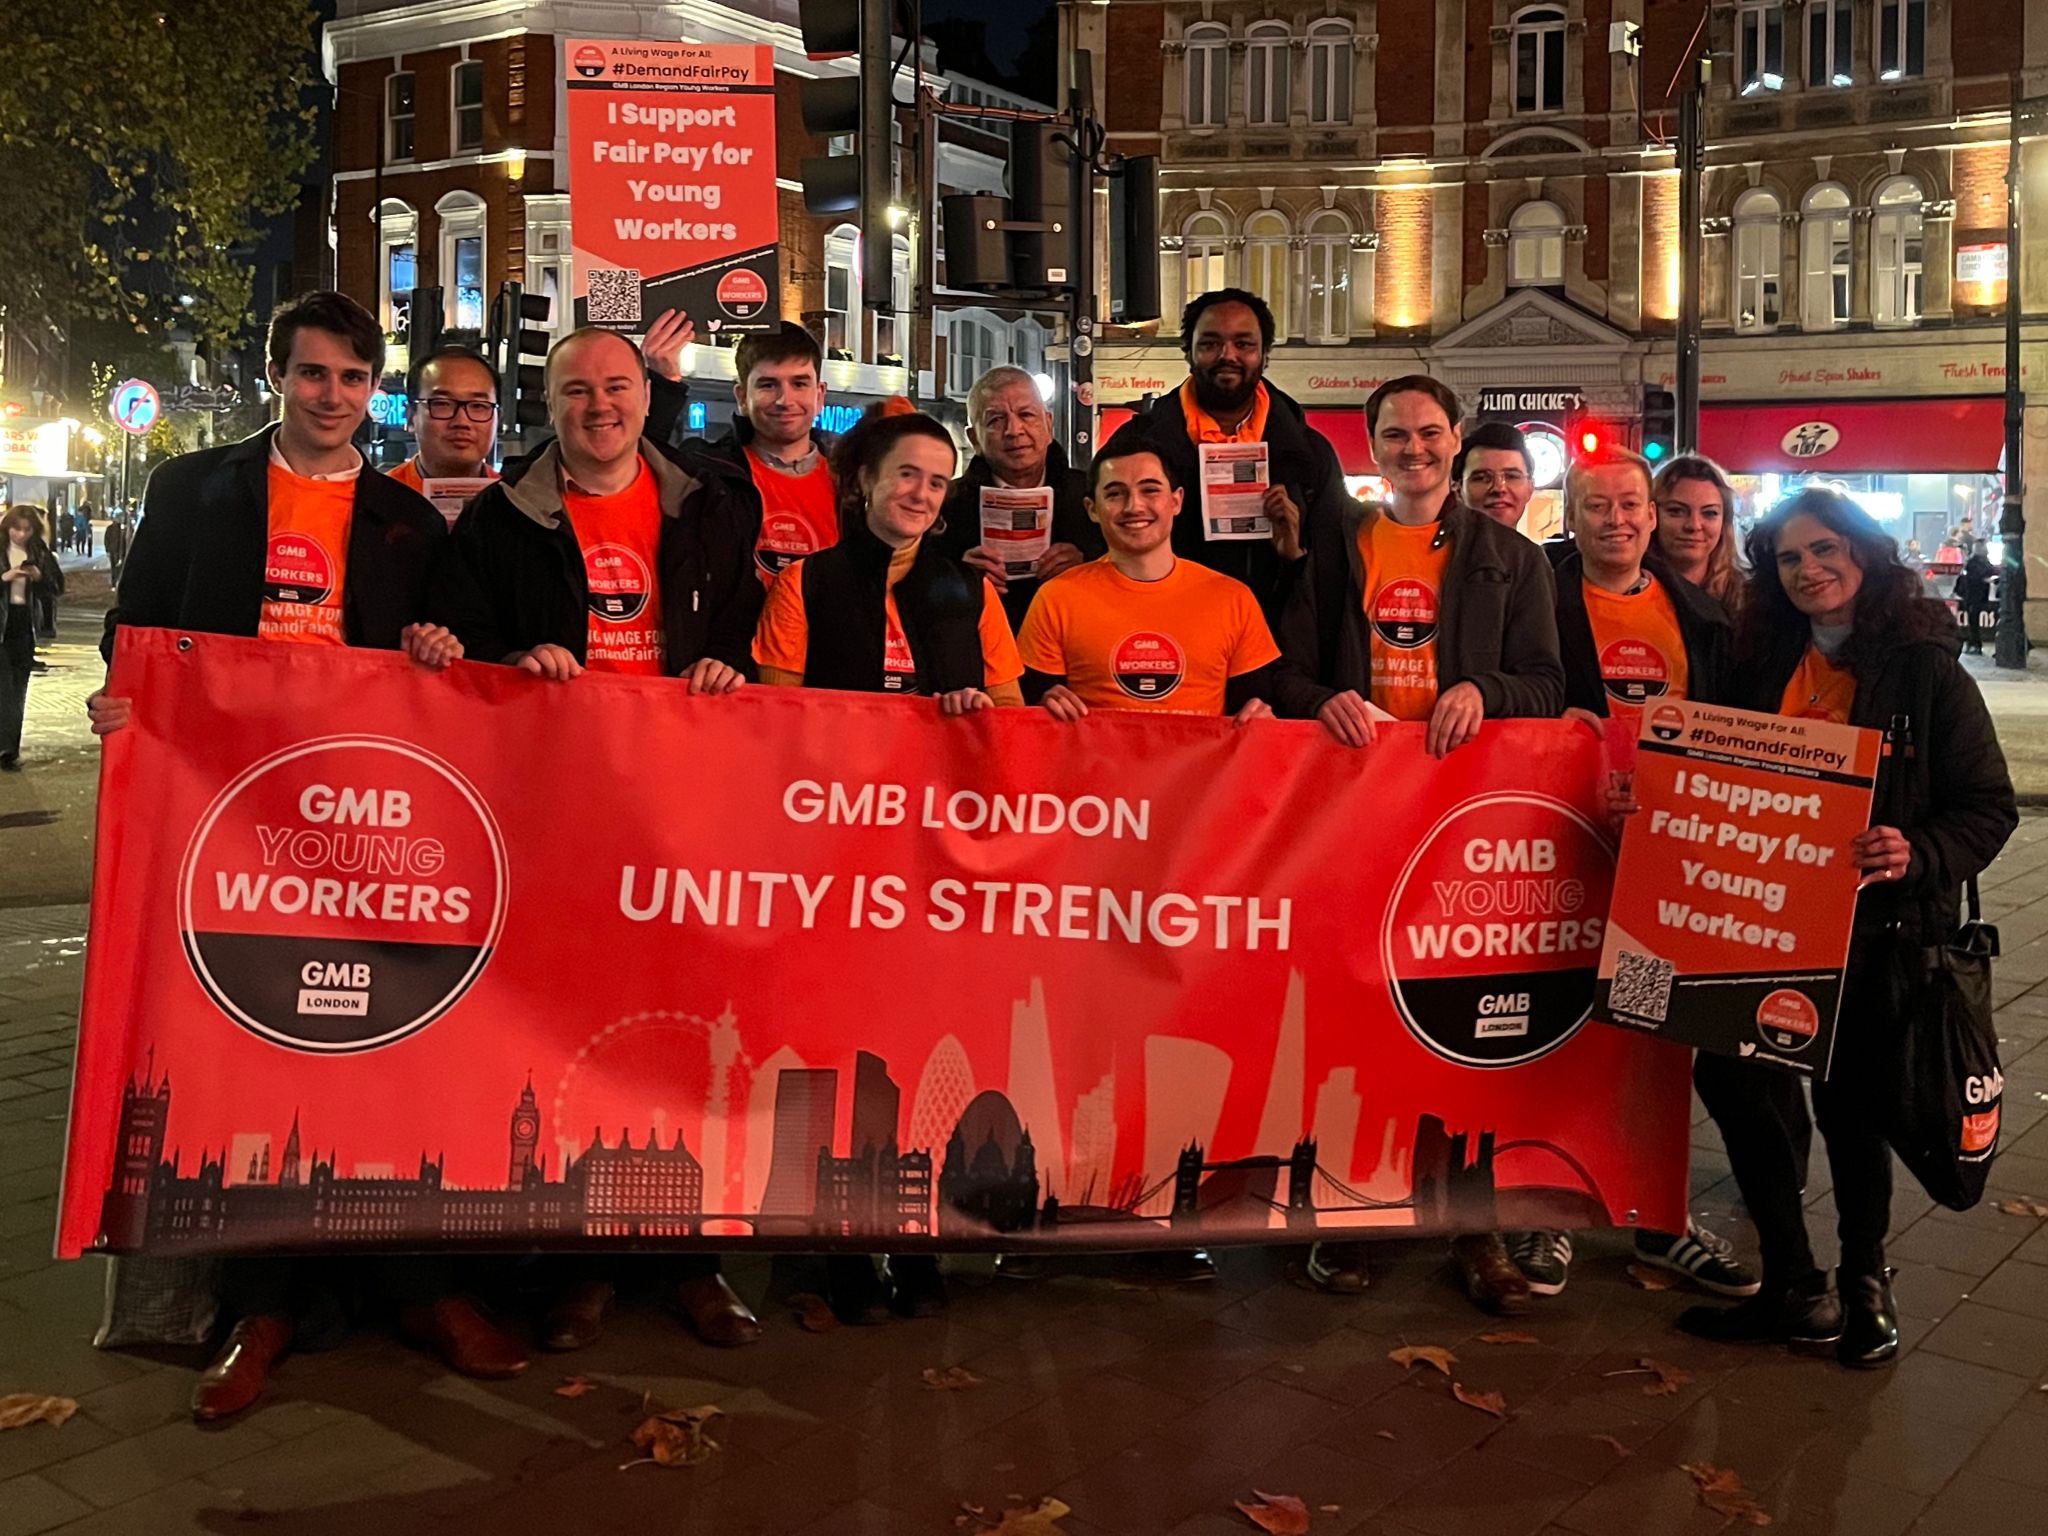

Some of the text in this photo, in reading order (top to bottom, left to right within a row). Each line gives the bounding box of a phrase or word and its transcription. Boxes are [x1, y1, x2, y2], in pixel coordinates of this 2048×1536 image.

[620, 48, 649, 58] Living
[651, 49, 679, 59] Wage
[681, 50, 696, 58] For
[612, 63, 749, 82] #DemandFairPay
[679, 84, 701, 92] Young
[608, 103, 736, 133] I Support
[593, 139, 753, 172] Fair Pay for
[627, 180, 721, 210] Young
[614, 218, 737, 240] Workers
[1130, 376, 1165, 388] Tenders
[1308, 376, 1350, 389] Chicken
[1847, 367, 1881, 380] Shakes
[371, 400, 388, 412] 20
[1483, 393, 1516, 410] SLIM
[277, 545, 307, 558] GMB
[594, 557, 622, 568] GMB
[1394, 588, 1420, 597] GMB
[270, 604, 313, 618] WAGE
[1378, 607, 1434, 619] WORKERS
[602, 630, 642, 646] WAGE
[1133, 640, 1159, 649] GMB
[1619, 646, 1646, 656] GMB
[1119, 661, 1175, 670] WORKERS
[1387, 657, 1424, 673] WAGE
[1604, 665, 1663, 677] WORKERS
[1702, 712, 1734, 727] Living
[1736, 717, 1769, 731] Wage
[1771, 723, 1788, 732] For
[1689, 728, 1847, 769] #DemandFairPay
[1674, 770, 1823, 820] I Support
[299, 784, 411, 828] GMB
[783, 779, 1150, 840] GMB LONDON
[1650, 810, 1834, 868] Fair Pay for
[256, 825, 445, 877] YOUNG
[1463, 838, 1557, 873] GMB
[1681, 859, 1787, 913] Young
[216, 871, 471, 924] WORKERS
[1432, 878, 1585, 917] YOUNG
[619, 865, 1291, 950] UNITY IS STRENGTH
[1657, 900, 1797, 953] Workers
[1407, 917, 1602, 960] WORKERS
[301, 961, 371, 988] GMB
[306, 997, 360, 1009] LONDON
[1478, 992, 1530, 1015] GMB
[1481, 1022, 1523, 1033] LONDON
